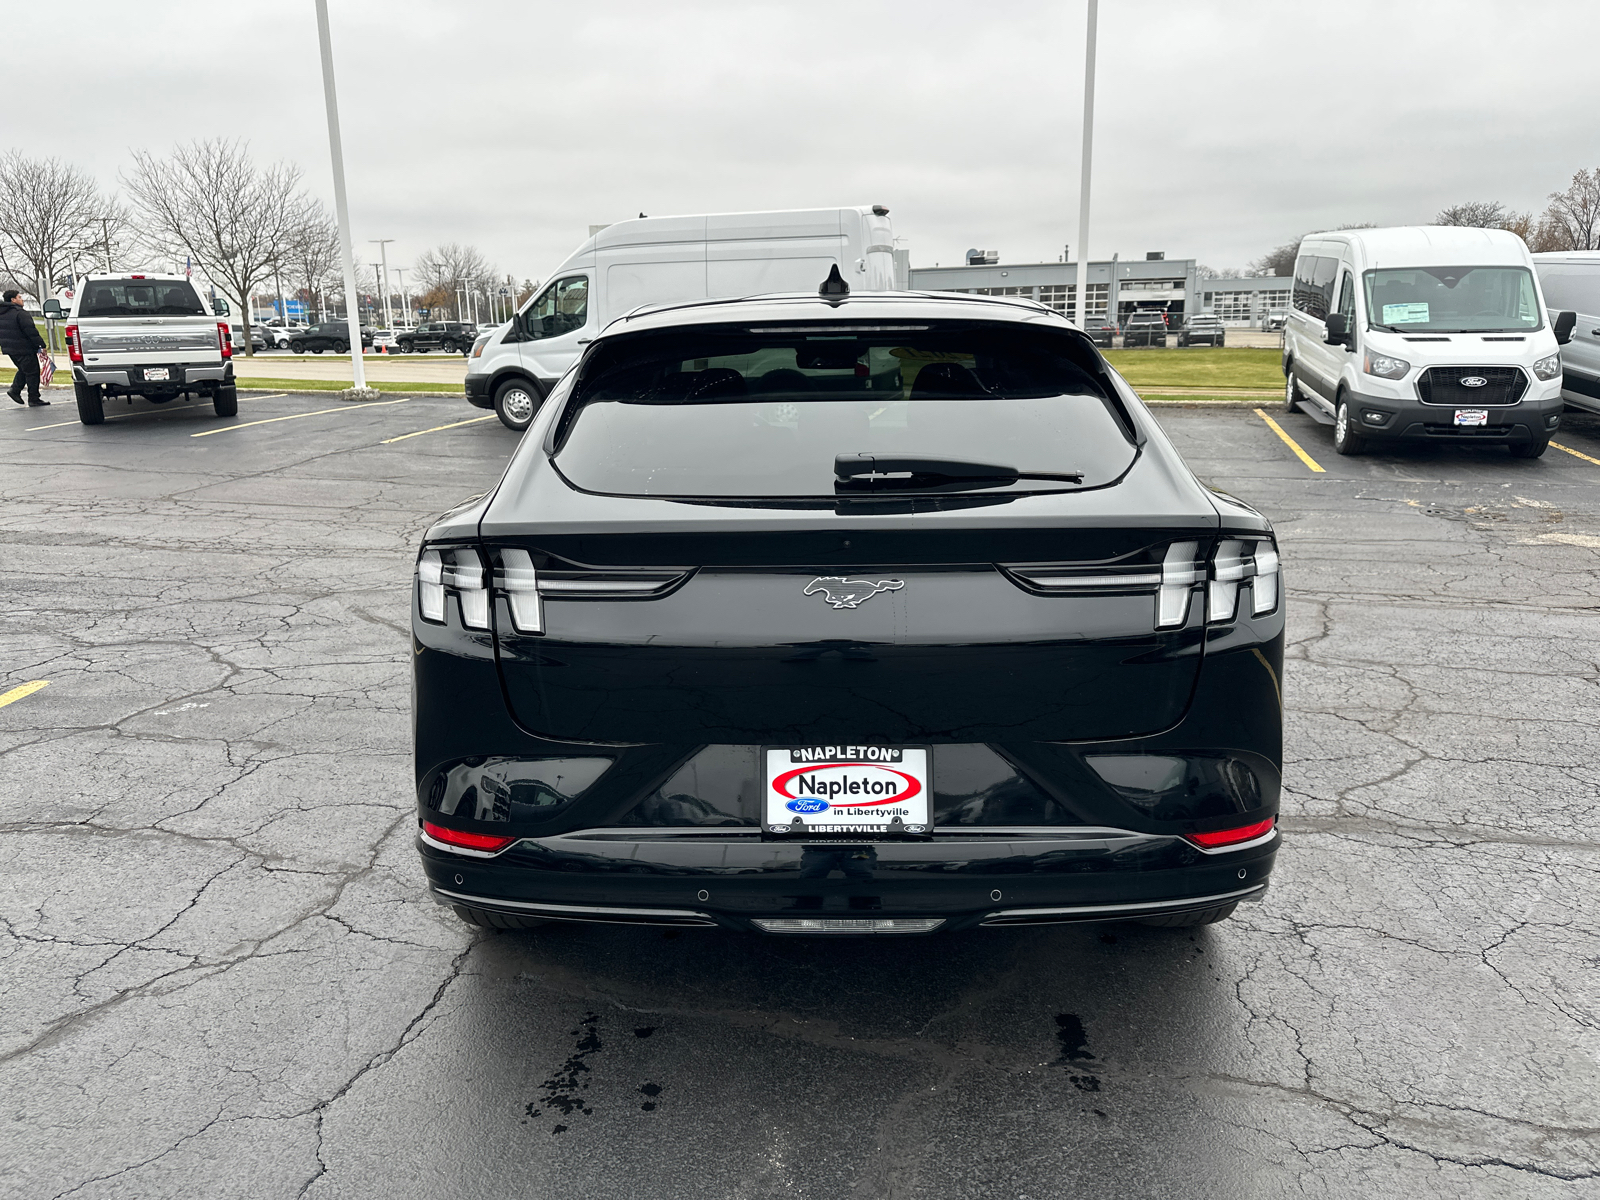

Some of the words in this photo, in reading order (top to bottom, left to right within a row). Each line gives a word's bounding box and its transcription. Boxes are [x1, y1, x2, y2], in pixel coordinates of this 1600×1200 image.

[801, 746, 892, 762] NAPLETON
[799, 775, 897, 799] Napleton
[794, 800, 821, 811] Ford
[834, 808, 843, 816] in
[847, 808, 909, 818] Libertyville
[808, 825, 887, 833] LIBERTYVILLE
